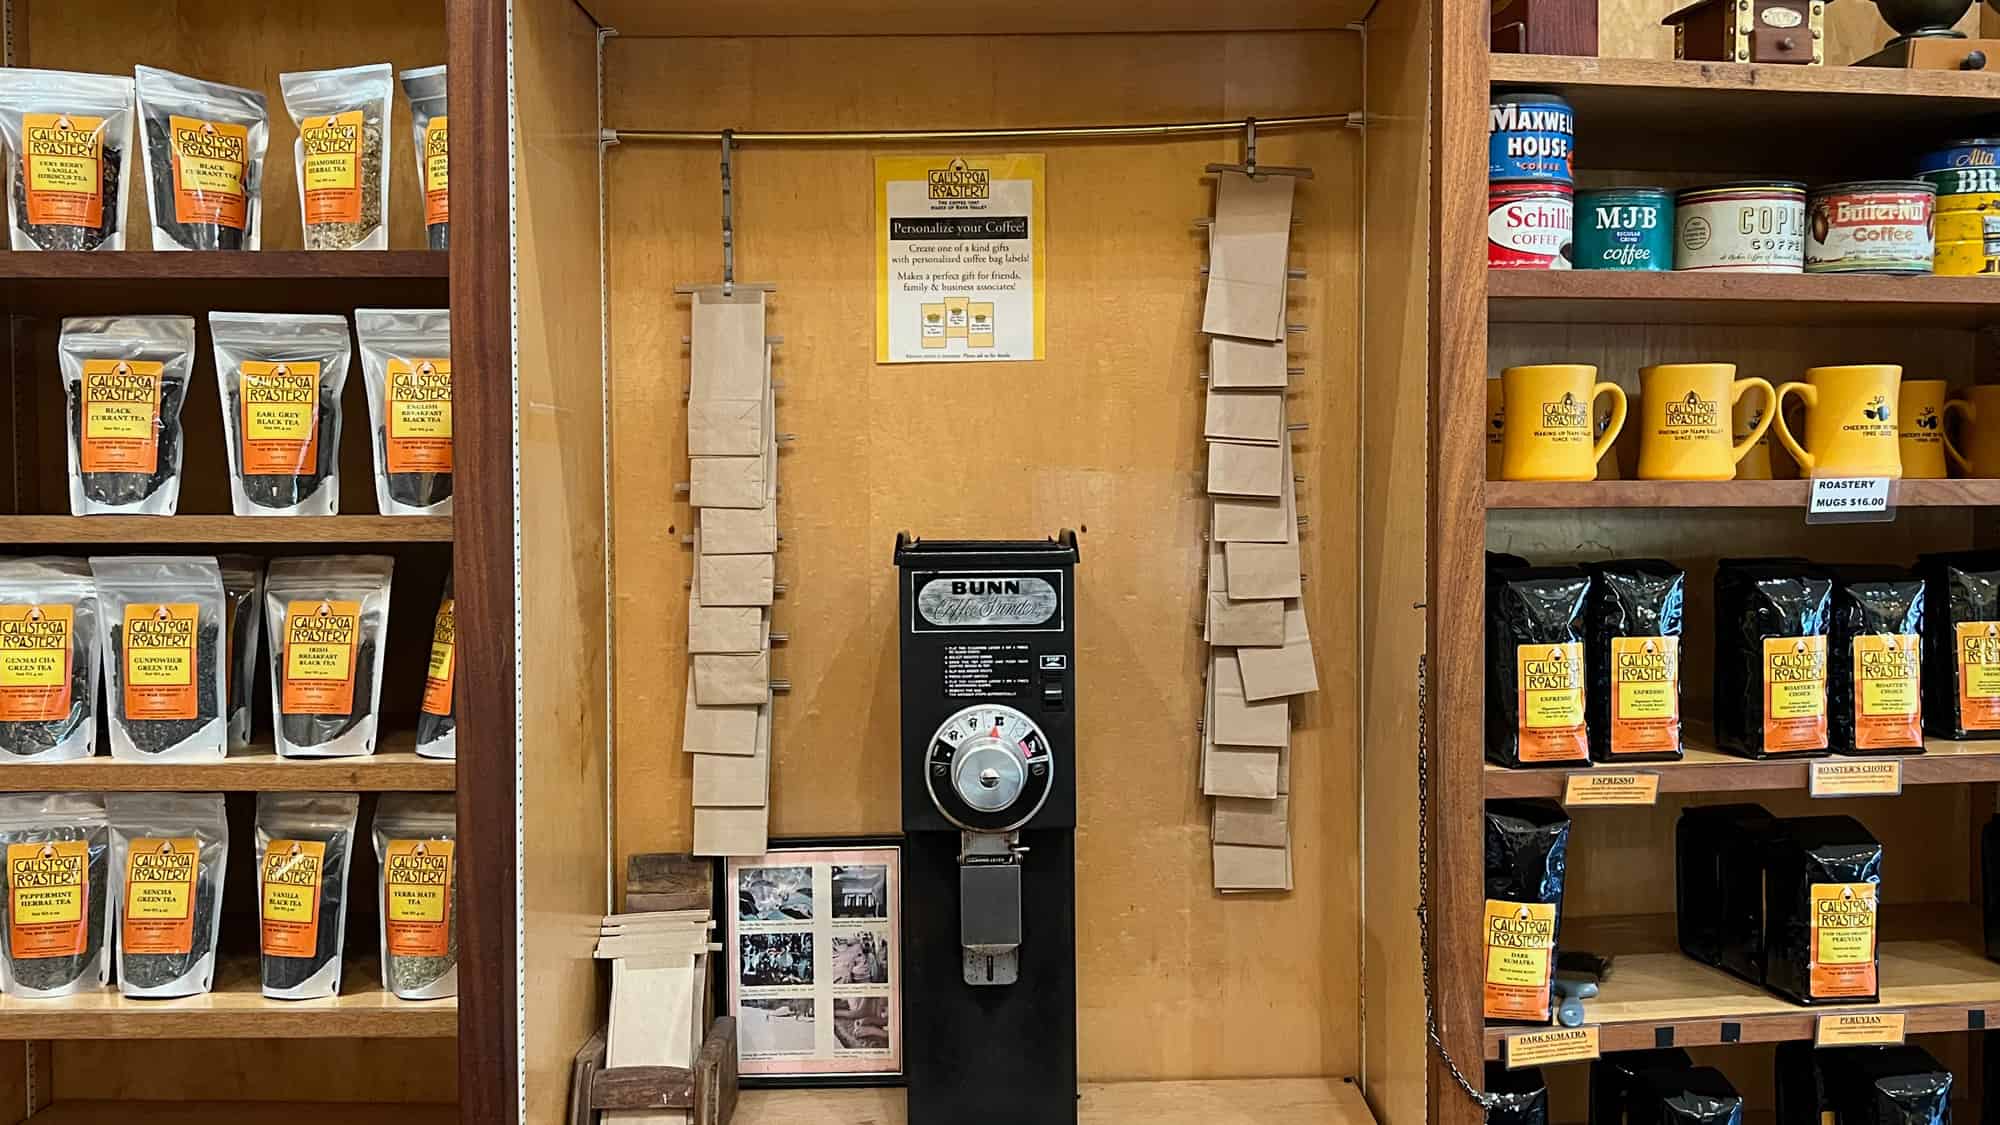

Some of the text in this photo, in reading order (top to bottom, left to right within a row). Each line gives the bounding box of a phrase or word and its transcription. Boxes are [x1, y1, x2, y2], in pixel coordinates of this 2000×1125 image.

[31, 129, 96, 145] CALISTOGA
[179, 131, 239, 149] CALISTOGA
[305, 125, 354, 143] CALISTOGA
[33, 141, 94, 157] ROASTERY
[182, 143, 240, 161] ROASTERY
[1508, 136, 1567, 158] HOUSE
[1956, 148, 1996, 166] Alta
[199, 163, 225, 171] BLACK
[931, 171, 987, 184] CALISTOGA
[1957, 168, 2000, 193] BR
[932, 185, 985, 198] ROASTERY
[1837, 198, 1925, 222] Butter-Nut
[1507, 205, 1571, 230] Schilli
[894, 221, 1026, 236] Personalize your Coffee!
[1852, 226, 1914, 242] Coffee
[1512, 234, 1560, 245] COFFEE
[908, 244, 934, 252] Create
[953, 244, 963, 252] of
[971, 243, 990, 252] kind
[992, 243, 1009, 254] gifts
[1603, 245, 1650, 264] coffee
[892, 254, 1030, 265] with personalized coffee bag labels!
[898, 272, 924, 280] Makes
[932, 271, 959, 282] perfect
[961, 271, 975, 282] gift
[977, 271, 989, 280] for
[991, 271, 1021, 280] friends,
[903, 283, 928, 293] family
[941, 283, 974, 291] business
[976, 282, 1016, 291] associates!
[90, 375, 152, 388] CALISTOGA
[250, 375, 311, 388] CALISTOGA
[91, 388, 151, 402] ROASTERY
[250, 389, 310, 402] ROASTERY
[1667, 402, 1716, 416] CALISTOGA
[1668, 414, 1715, 427] ROASTERY
[1819, 480, 1875, 489] ROASTERY
[1816, 497, 1884, 507] MUGS $16.00
[951, 581, 1020, 595] BUNN
[935, 598, 977, 623] Coffee
[2, 622, 63, 634] CALISTOGA
[131, 622, 189, 634] CALISTOGA
[294, 616, 350, 629] CALISTOGA
[3, 635, 62, 649] ROASTERY
[132, 634, 187, 648] ROASTERY
[293, 630, 349, 643] ROASTERY
[1773, 654, 1824, 667] CALISTO
[1863, 653, 1916, 665] CALISTO
[1526, 661, 1580, 674] CALISTO
[1528, 674, 1578, 689] ROASTE
[1818, 765, 1895, 775] ROASTER'S CHOICE
[1591, 776, 1635, 785] ESPRESSO
[16, 858, 78, 872] CALISTOGA
[135, 855, 190, 867] CALISTOGA
[269, 855, 315, 870] CALIOGA
[392, 856, 444, 869] CALISTOGA
[17, 870, 79, 886] ROASTERY
[135, 868, 188, 881] ROASTERY
[268, 869, 313, 884] RASTERY
[392, 870, 442, 884] ROASTERY
[20, 891, 72, 900] PEPPERMINT
[269, 898, 290, 906] BLACK
[1492, 919, 1549, 933] CALISTOGA
[1822, 914, 1870, 927] ROASTERY
[1840, 1015, 1882, 1025] PERUVIAN
[1520, 1030, 1587, 1045] DARK SUMATRA
